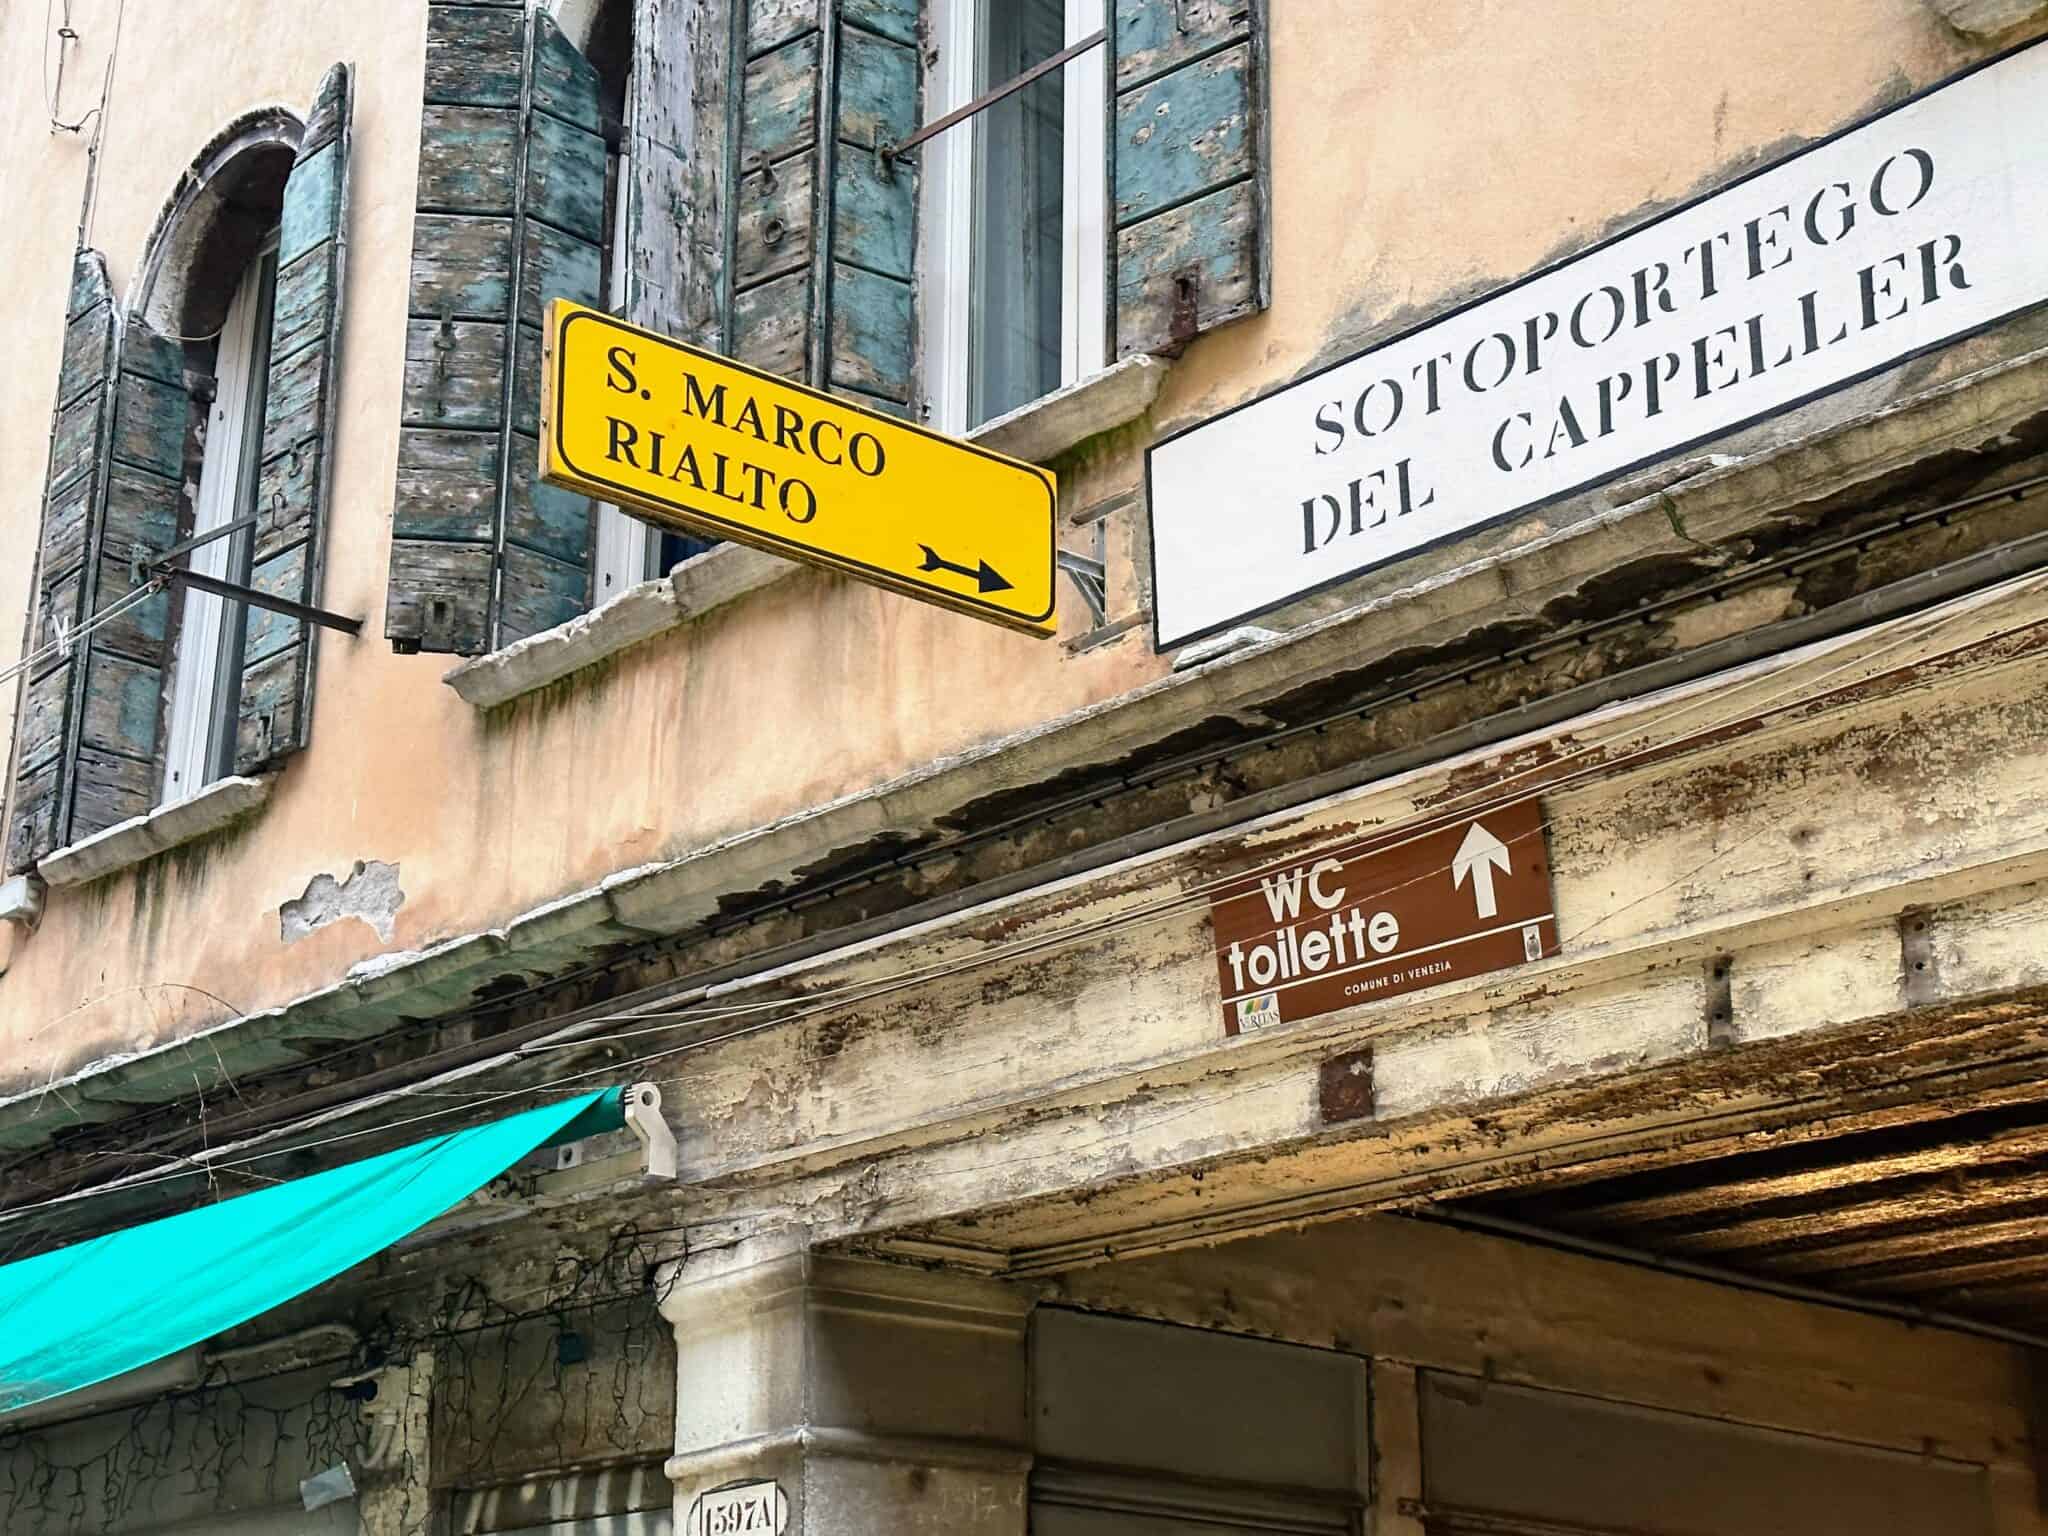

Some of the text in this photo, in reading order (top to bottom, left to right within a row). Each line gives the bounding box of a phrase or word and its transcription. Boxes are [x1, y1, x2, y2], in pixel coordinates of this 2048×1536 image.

[1313, 147, 1935, 457] SOTOPORTEGO
[606, 346, 886, 477] S. MARCO
[1300, 233, 1972, 556] DEL CAPPELLER
[604, 415, 817, 524] RIALTO
[1261, 858, 1346, 923] WC
[1228, 908, 1399, 992] toilette
[1344, 960, 1452, 996] COMUNE DI VENEZIA
[706, 1497, 771, 1536] 1597A
